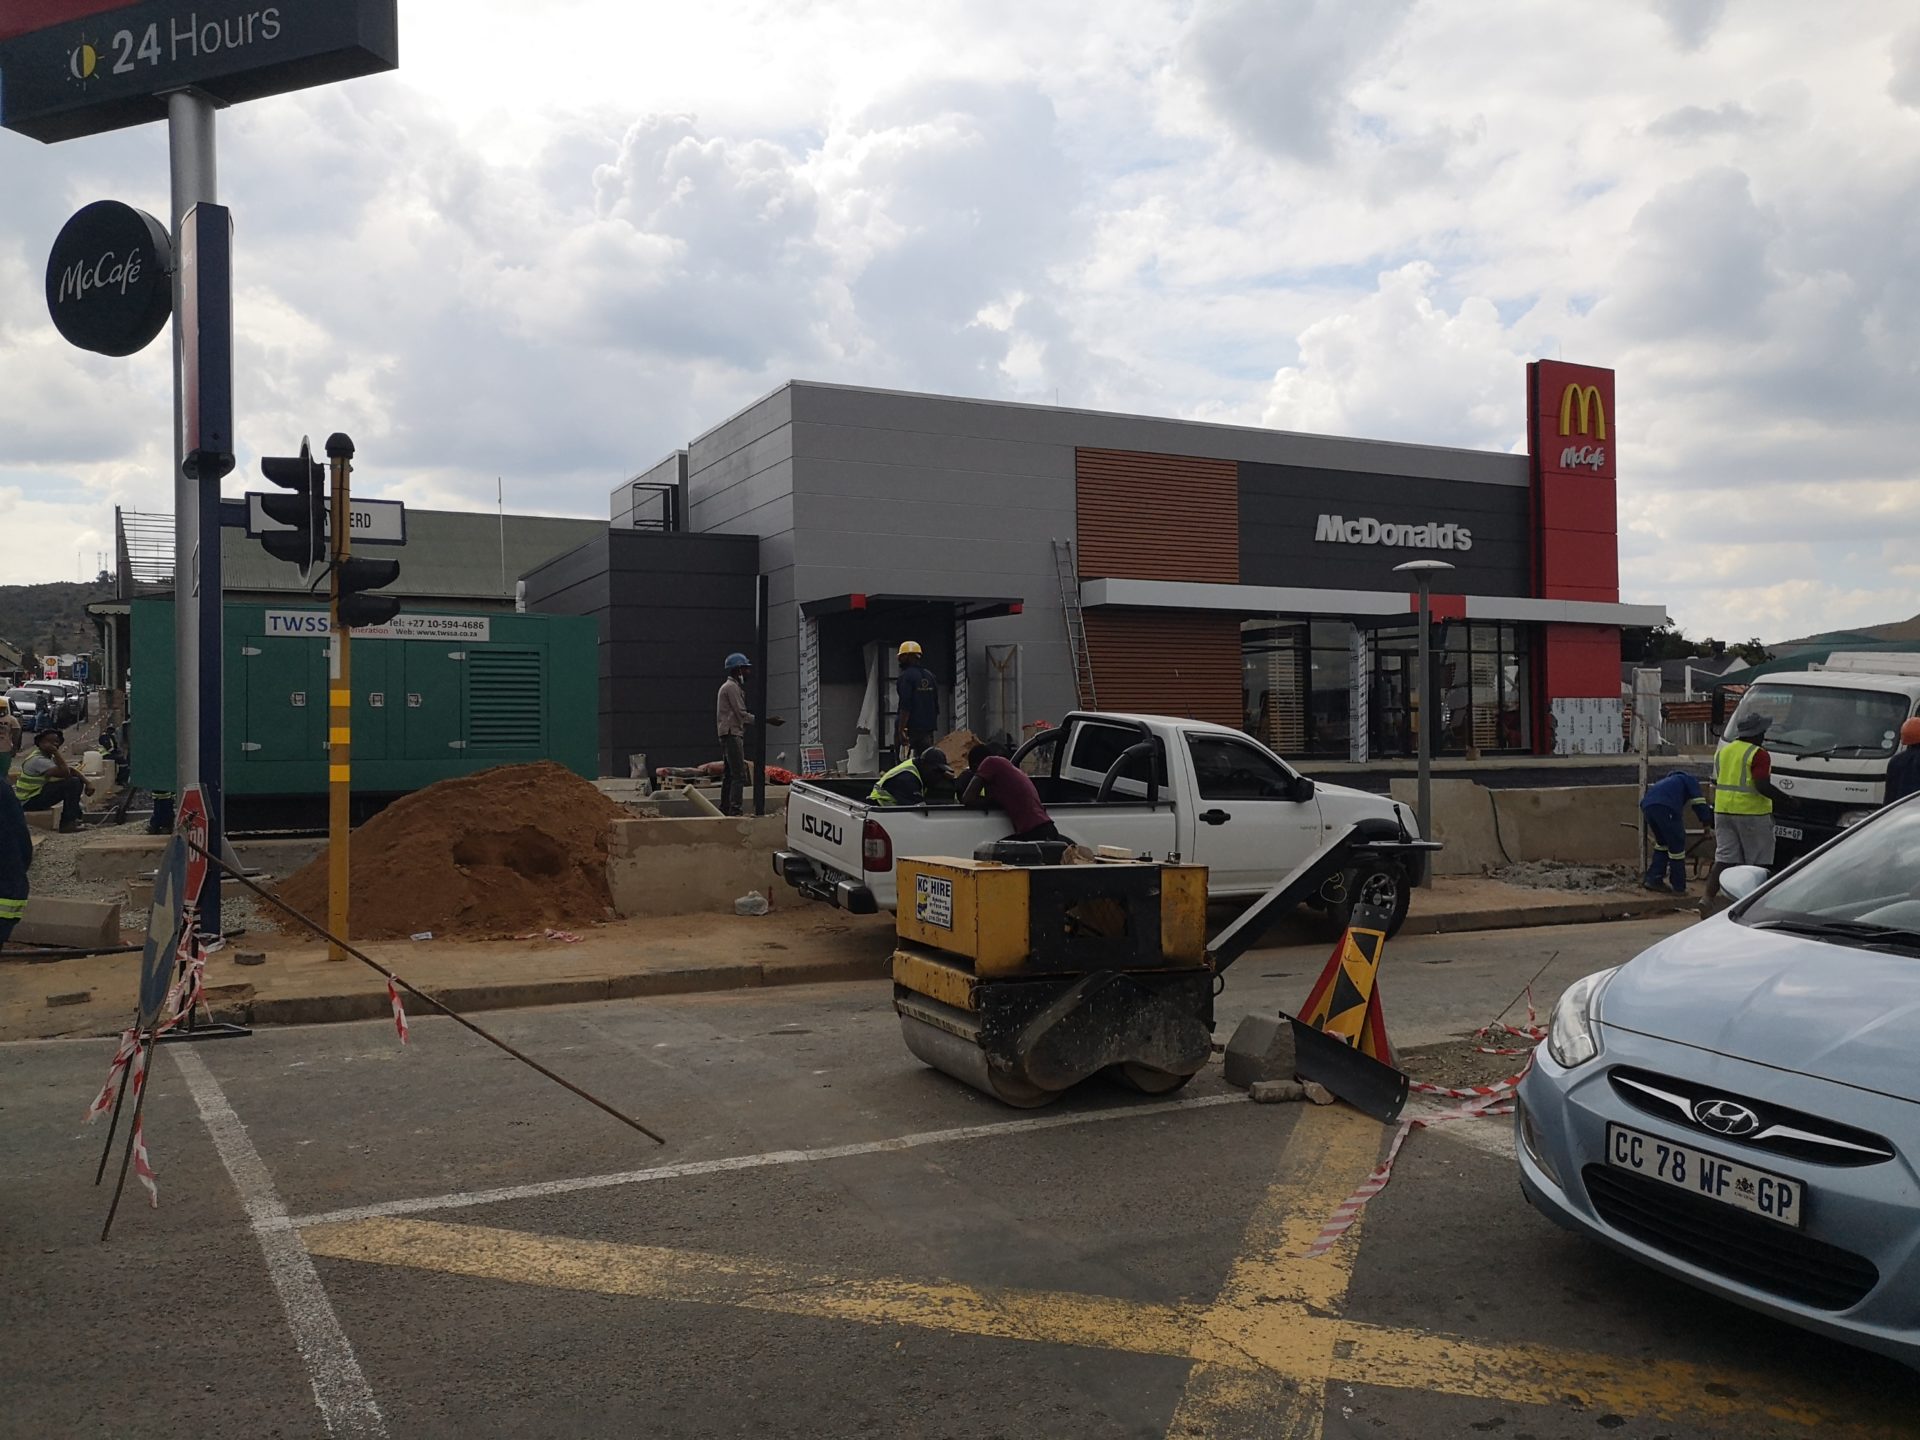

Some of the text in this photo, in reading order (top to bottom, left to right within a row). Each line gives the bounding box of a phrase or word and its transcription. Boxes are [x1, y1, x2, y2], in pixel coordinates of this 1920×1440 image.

[112, 8, 281, 74] 24 Hours
[59, 248, 141, 303] McCafé
[1559, 445, 1605, 471] McCafé
[350, 512, 371, 528] ERD
[1315, 514, 1472, 551] McDonald's
[269, 616, 329, 632] TWSS
[350, 627, 389, 635] eneration
[389, 618, 485, 630] Tel: +27 10-594-4686
[417, 629, 478, 637] www.twssa.co.za
[802, 812, 843, 846] ISUZU
[917, 877, 951, 897] KC HIRE
[1615, 1131, 1793, 1218] CC 78 WF GP
